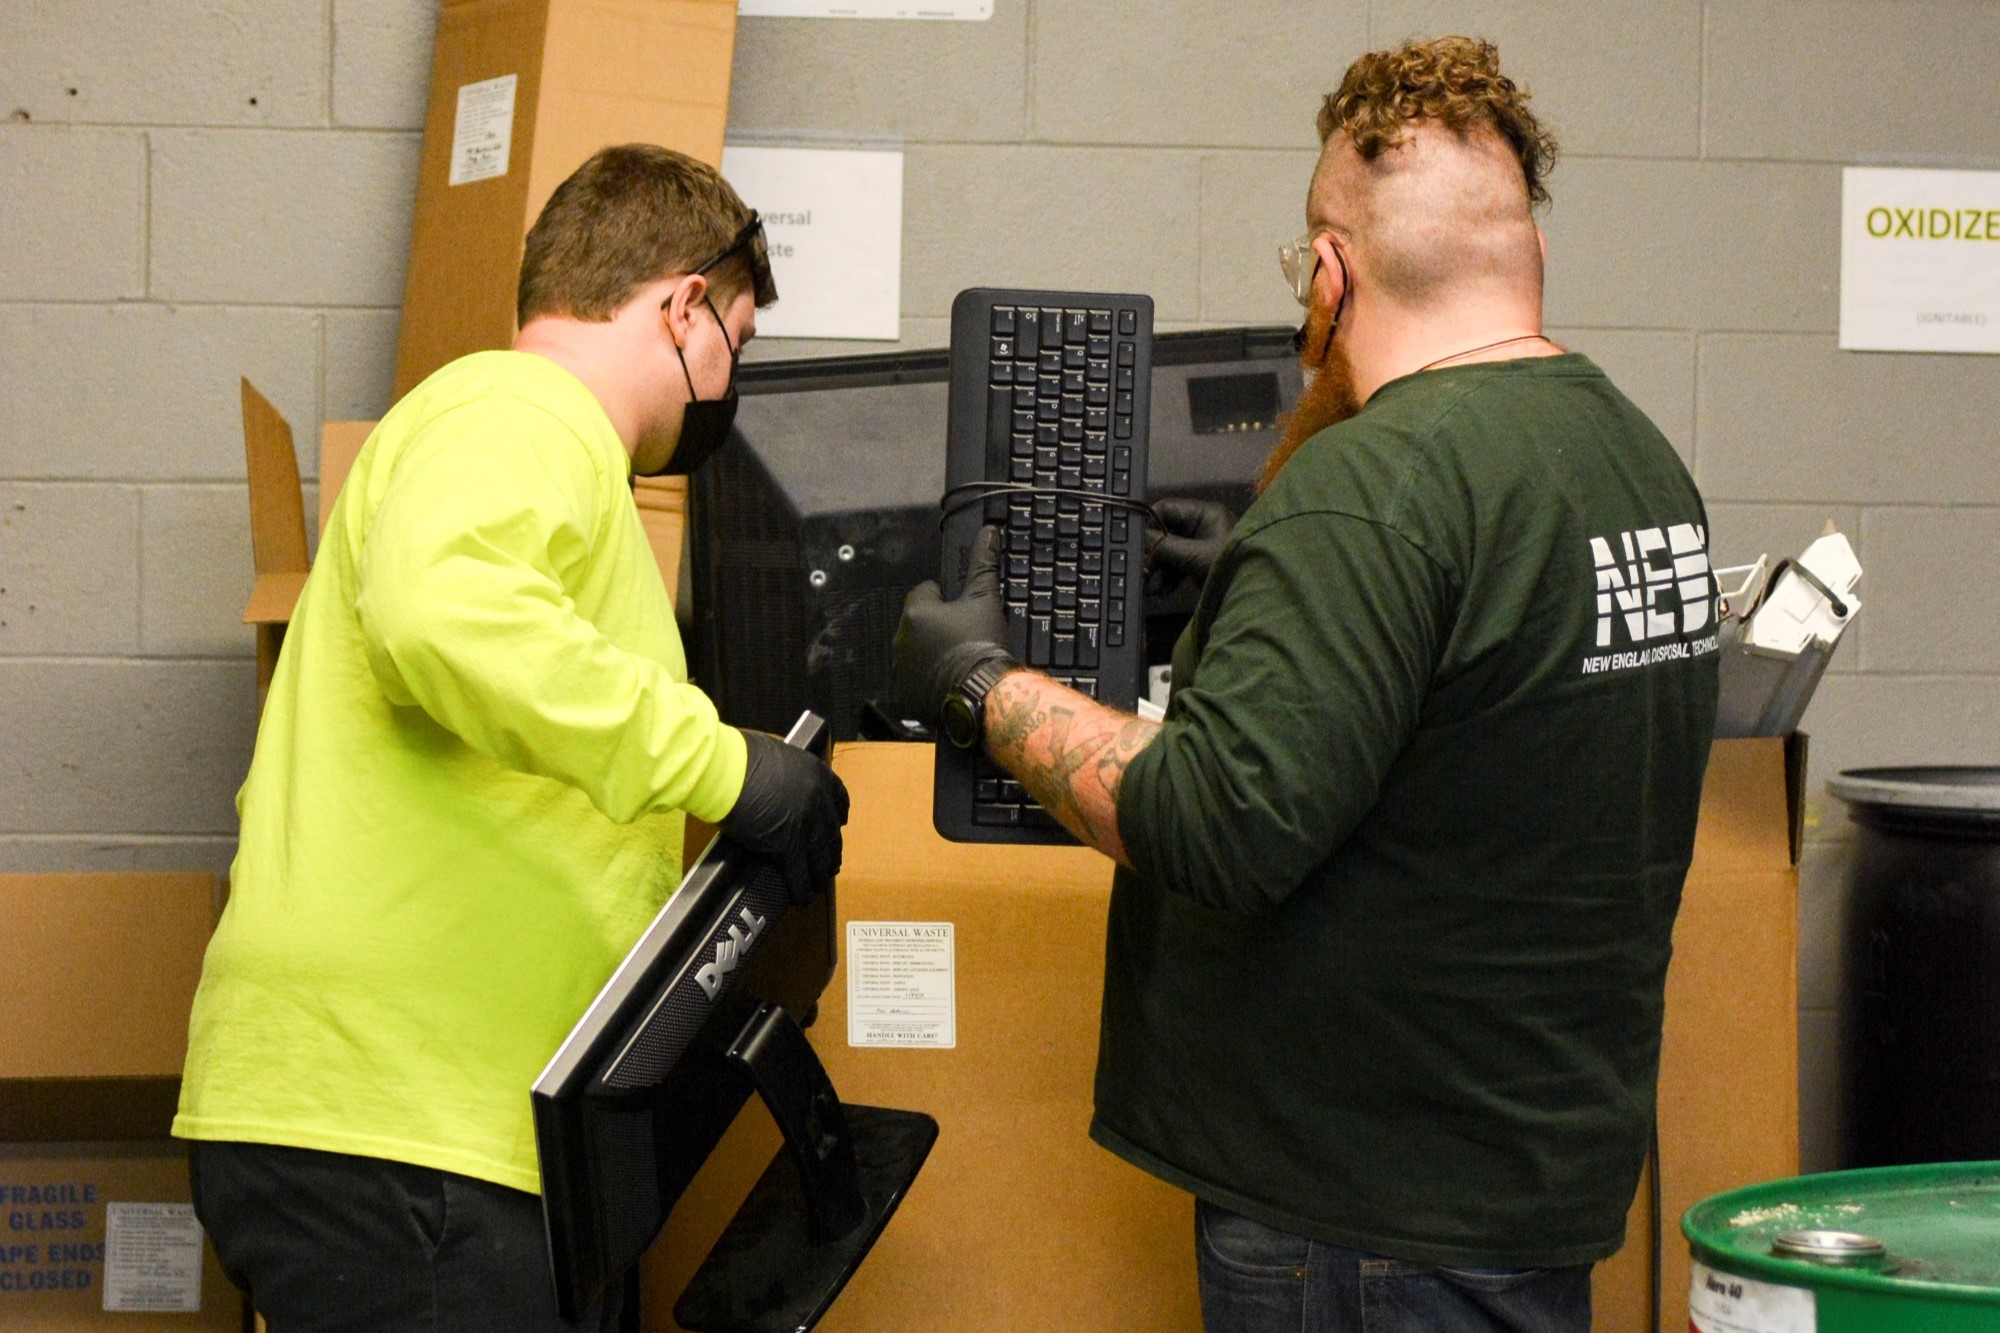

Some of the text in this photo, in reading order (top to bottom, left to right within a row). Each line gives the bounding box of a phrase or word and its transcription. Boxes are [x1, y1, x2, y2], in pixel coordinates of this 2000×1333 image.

[1866, 206, 2000, 242] OXIDIZE
[1582, 655, 1611, 674] NEW
[1651, 642, 1690, 663] DISPOSAL
[853, 928, 949, 938] UNIVERSAL WASTE
[694, 906, 767, 1001] DELL
[0, 1184, 97, 1204] FRAGILE
[9, 1210, 85, 1231] GLASS
[0, 1269, 92, 1291] CLOSED
